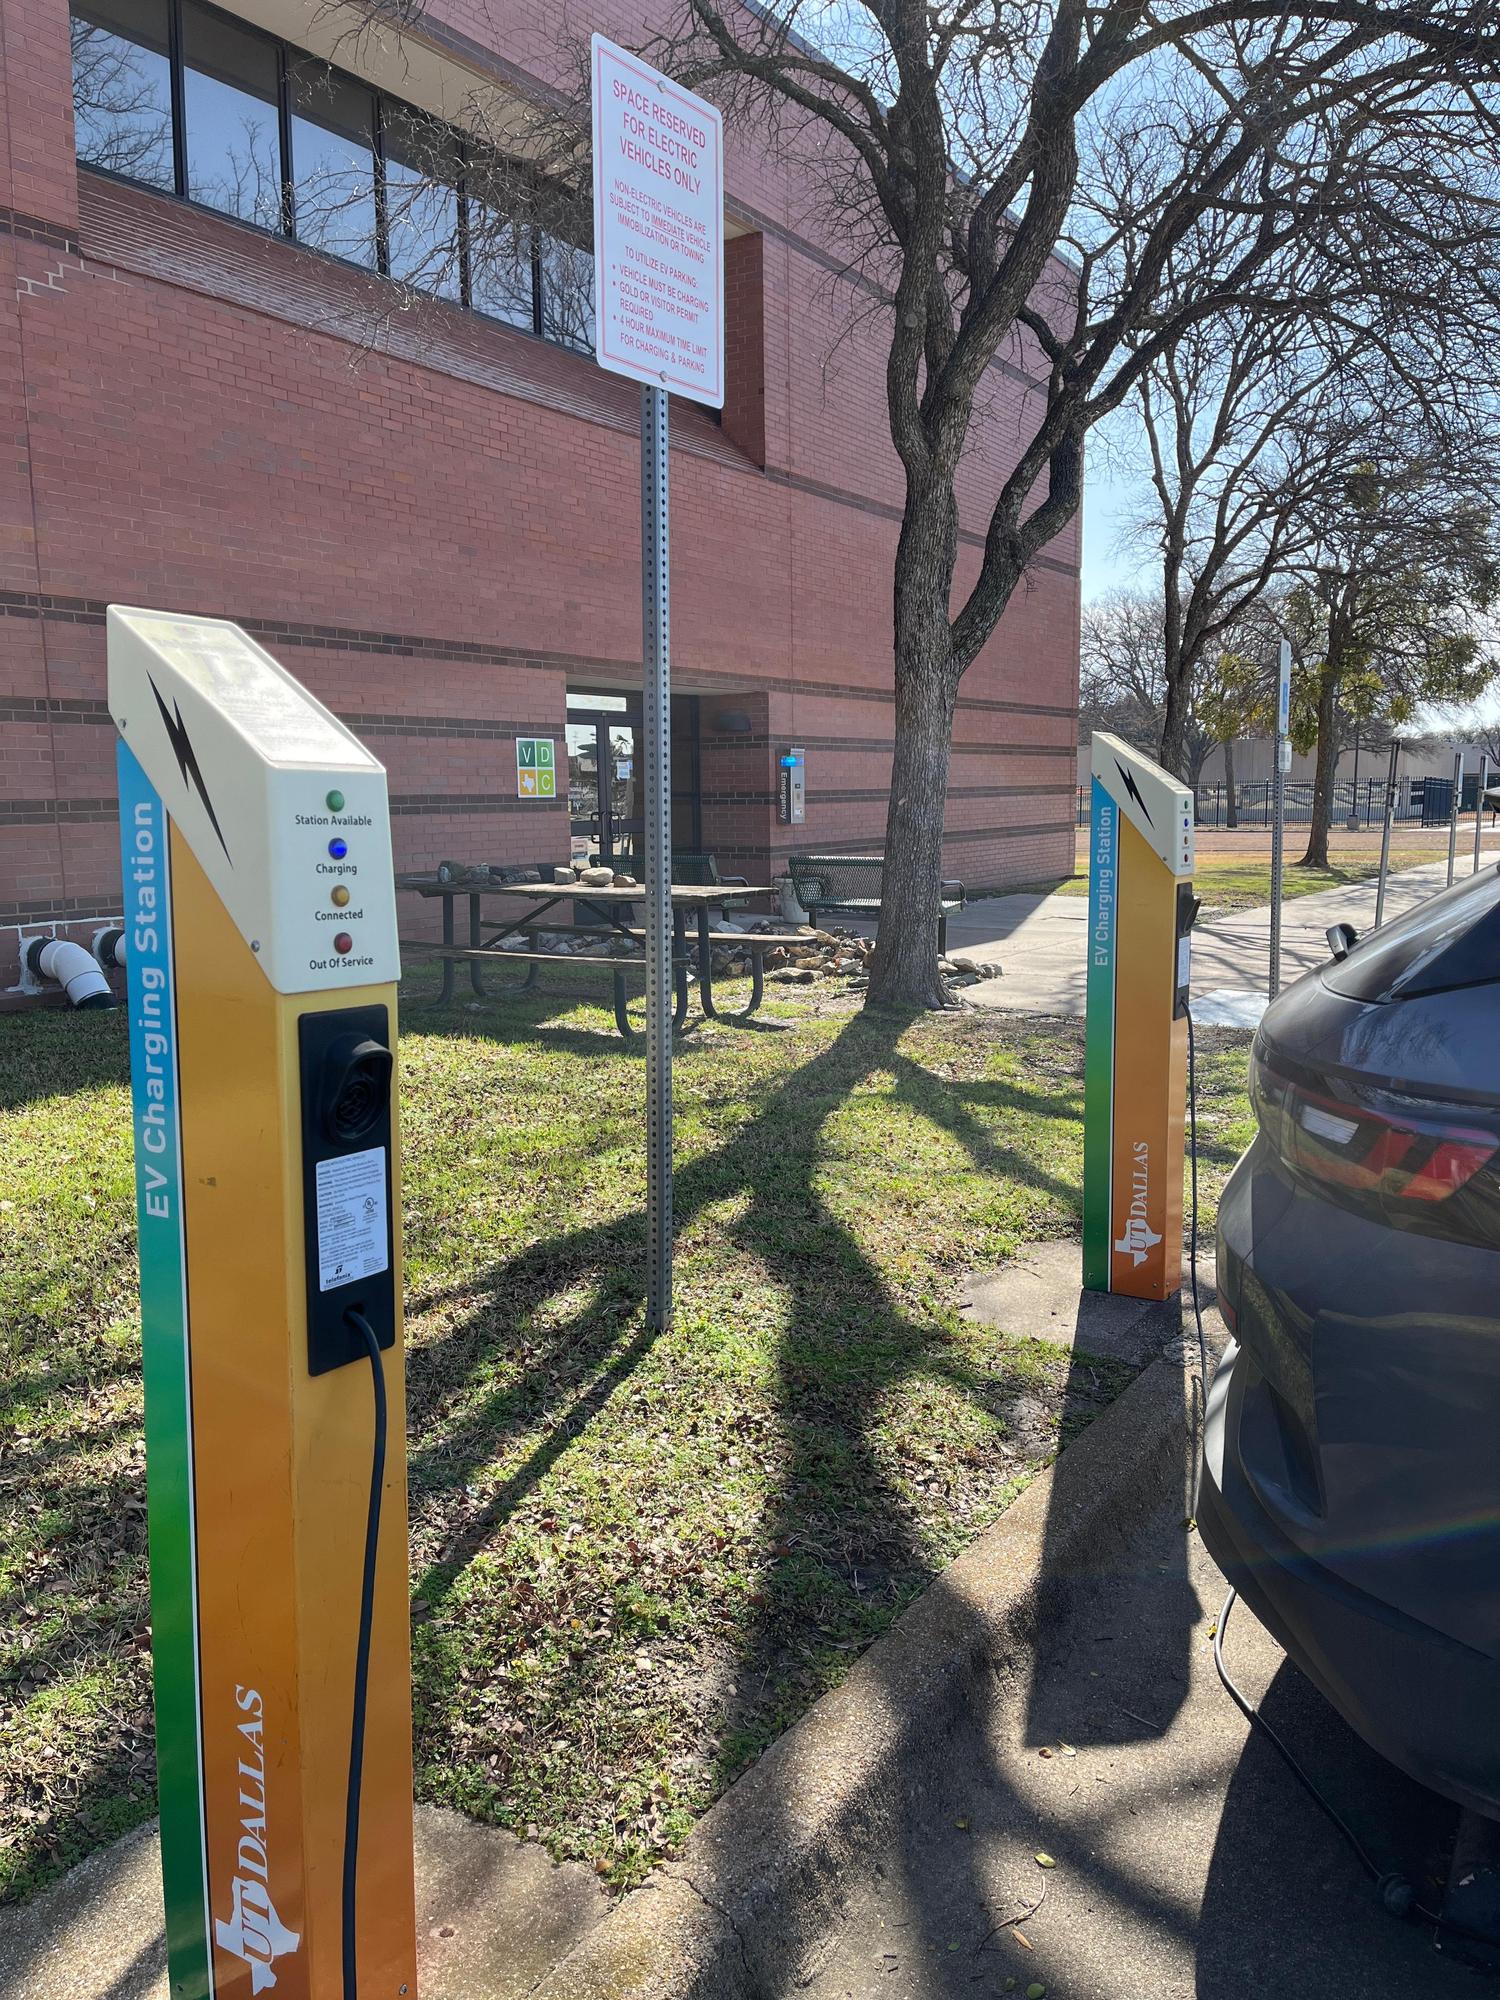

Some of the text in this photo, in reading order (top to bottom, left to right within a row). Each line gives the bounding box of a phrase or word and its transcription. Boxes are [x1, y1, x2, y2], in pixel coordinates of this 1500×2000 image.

[613, 79, 706, 149] SPACE RESERVED
[623, 112, 698, 169] FOR ELECTRIC
[620, 136, 701, 196] VEHICLES ONLY
[609, 193, 711, 252] SUBJECT TO IMMEDIATE VEHICLE
[614, 180, 706, 235] NON-ELECTRIC VEHICLES ARE
[617, 213, 705, 263] IMMOBILIZATION OR TOWING
[619, 264, 709, 312] VEHICLE MUST BE CHARGING
[625, 245, 698, 288] TO UTILIZE EV PARKING:
[619, 281, 699, 324] GOLD OR VISITOR PERMIT
[620, 298, 653, 321] REQUIRED
[620, 332, 635, 347] FOR
[635, 339, 669, 361] CHARGING
[678, 355, 705, 374] PARKING
[625, 317, 645, 334] HOUR
[645, 324, 676, 346] MAXIMUM
[676, 335, 692, 350] TIME
[692, 341, 708, 358] LIMIT
[522, 747, 550, 763] V D
[541, 774, 551, 790] C
[295, 815, 372, 827] Station Available
[315, 863, 358, 876] Charging
[1095, 806, 1113, 966] EV Charging Station
[315, 908, 363, 921] Connected
[309, 956, 374, 970] Out Of Service
[131, 802, 170, 1219] EV Charging Station
[1130, 1141, 1149, 1252] UT DALLAS
[235, 1684, 274, 1964] UT DALLAS
